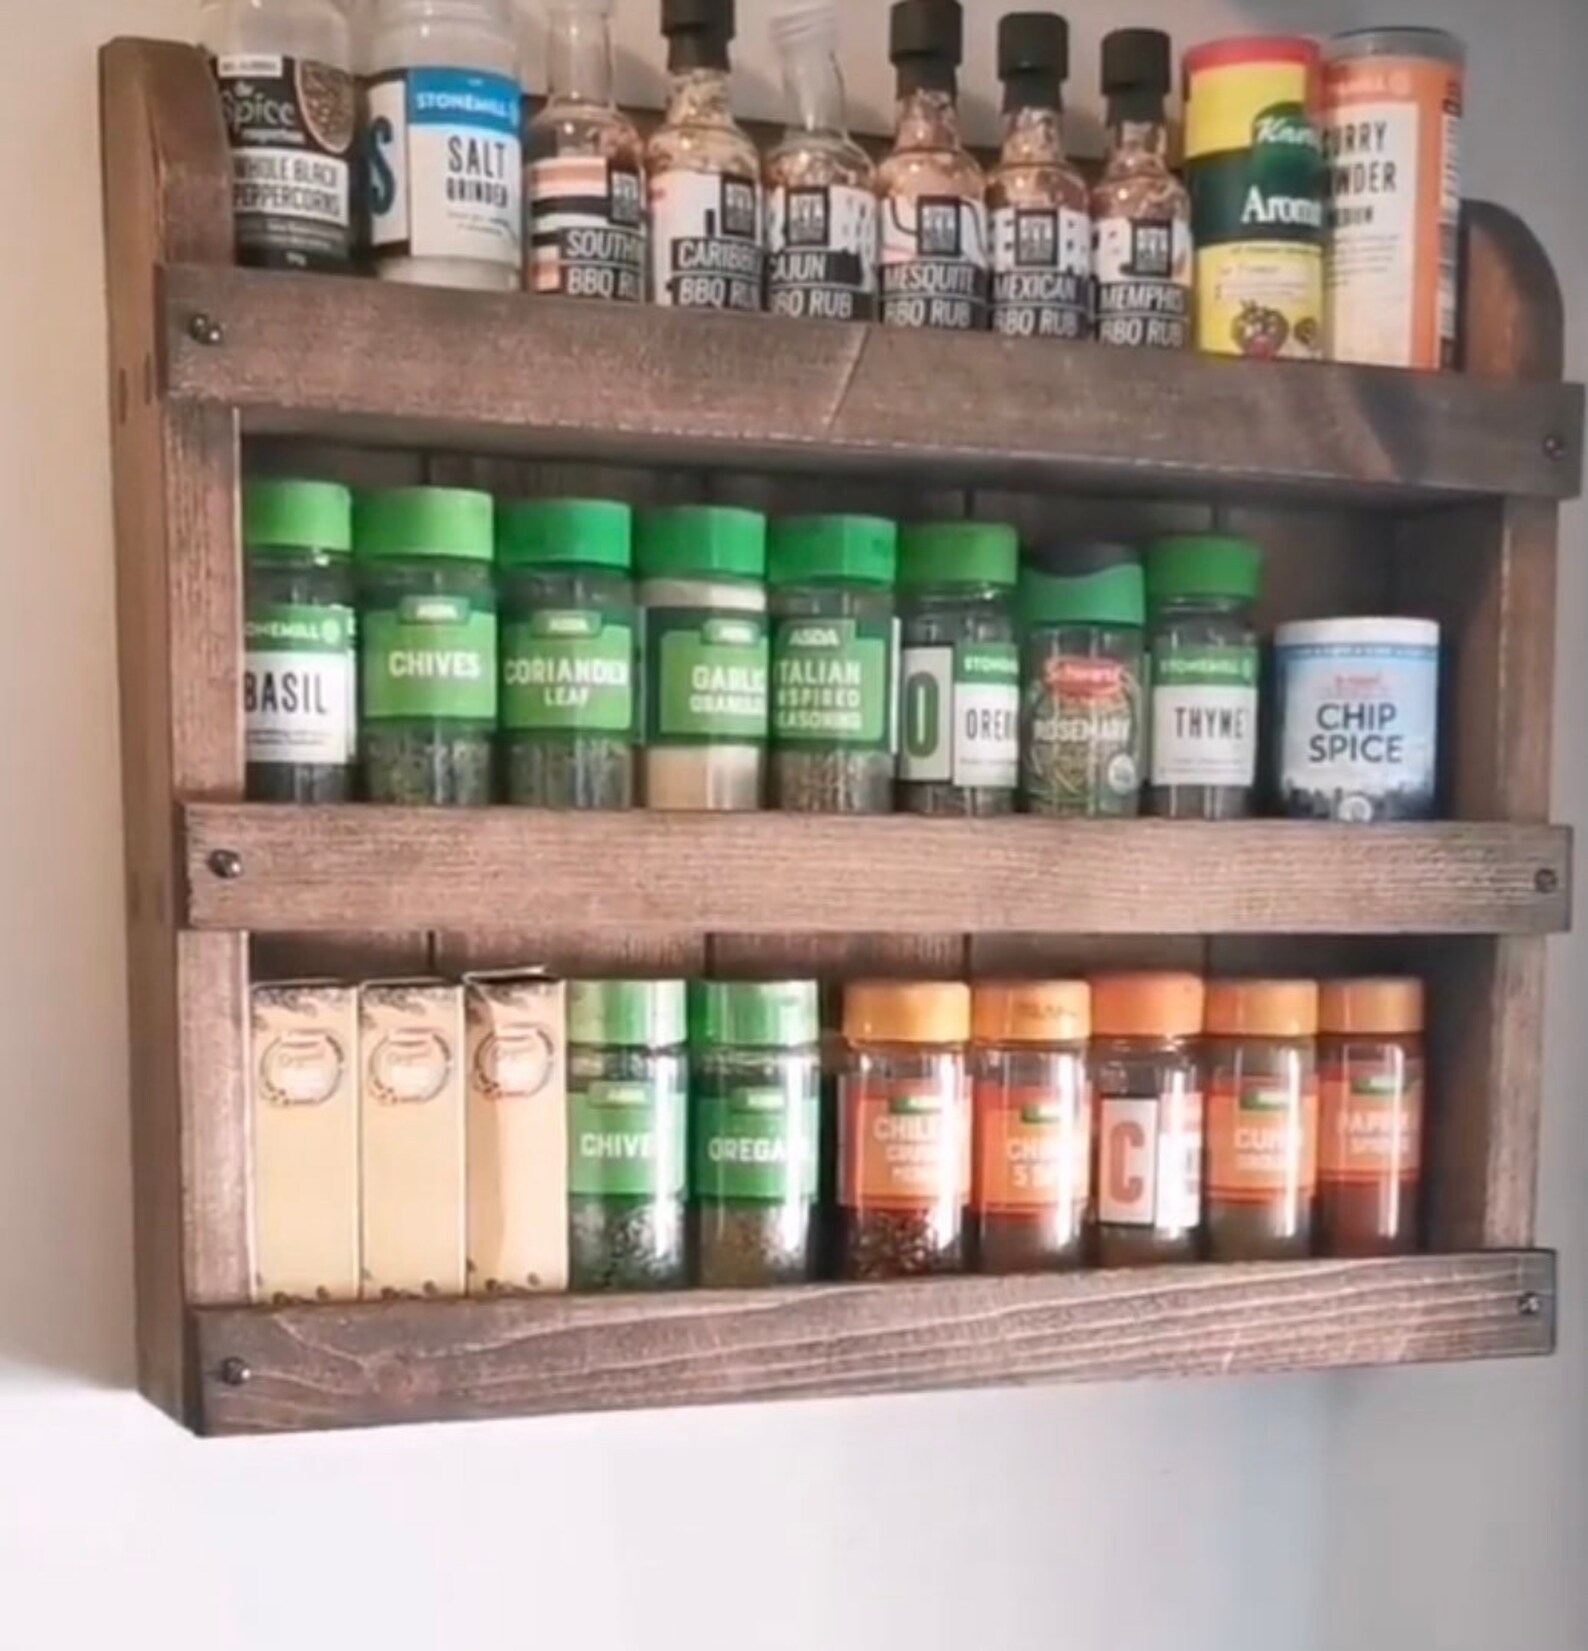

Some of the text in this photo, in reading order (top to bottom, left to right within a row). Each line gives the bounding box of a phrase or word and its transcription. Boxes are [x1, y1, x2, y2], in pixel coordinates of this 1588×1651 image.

[415, 90, 508, 119] STONEMILL
[447, 135, 507, 179] SALT
[293, 157, 338, 187] BLACK
[446, 177, 509, 209] GRINDER
[566, 229, 638, 263] SOUTH
[567, 267, 615, 298] BBQ
[679, 277, 726, 306] BBQ
[808, 291, 853, 318] RUB
[929, 301, 971, 328] RUB
[1039, 309, 1078, 336] RUB
[1146, 319, 1184, 347] RUB
[789, 628, 839, 646] ASDA
[388, 651, 481, 680] CHIVES
[777, 659, 862, 685] TALIAN
[243, 671, 328, 715] BASIL
[543, 687, 590, 707] LEAF
[1032, 718, 1130, 744] ROSEMARY
[1175, 706, 1245, 740] THYME
[1316, 702, 1397, 731] CHIP
[1308, 734, 1404, 764] SPICE
[580, 1132, 655, 1159] CHIVE
